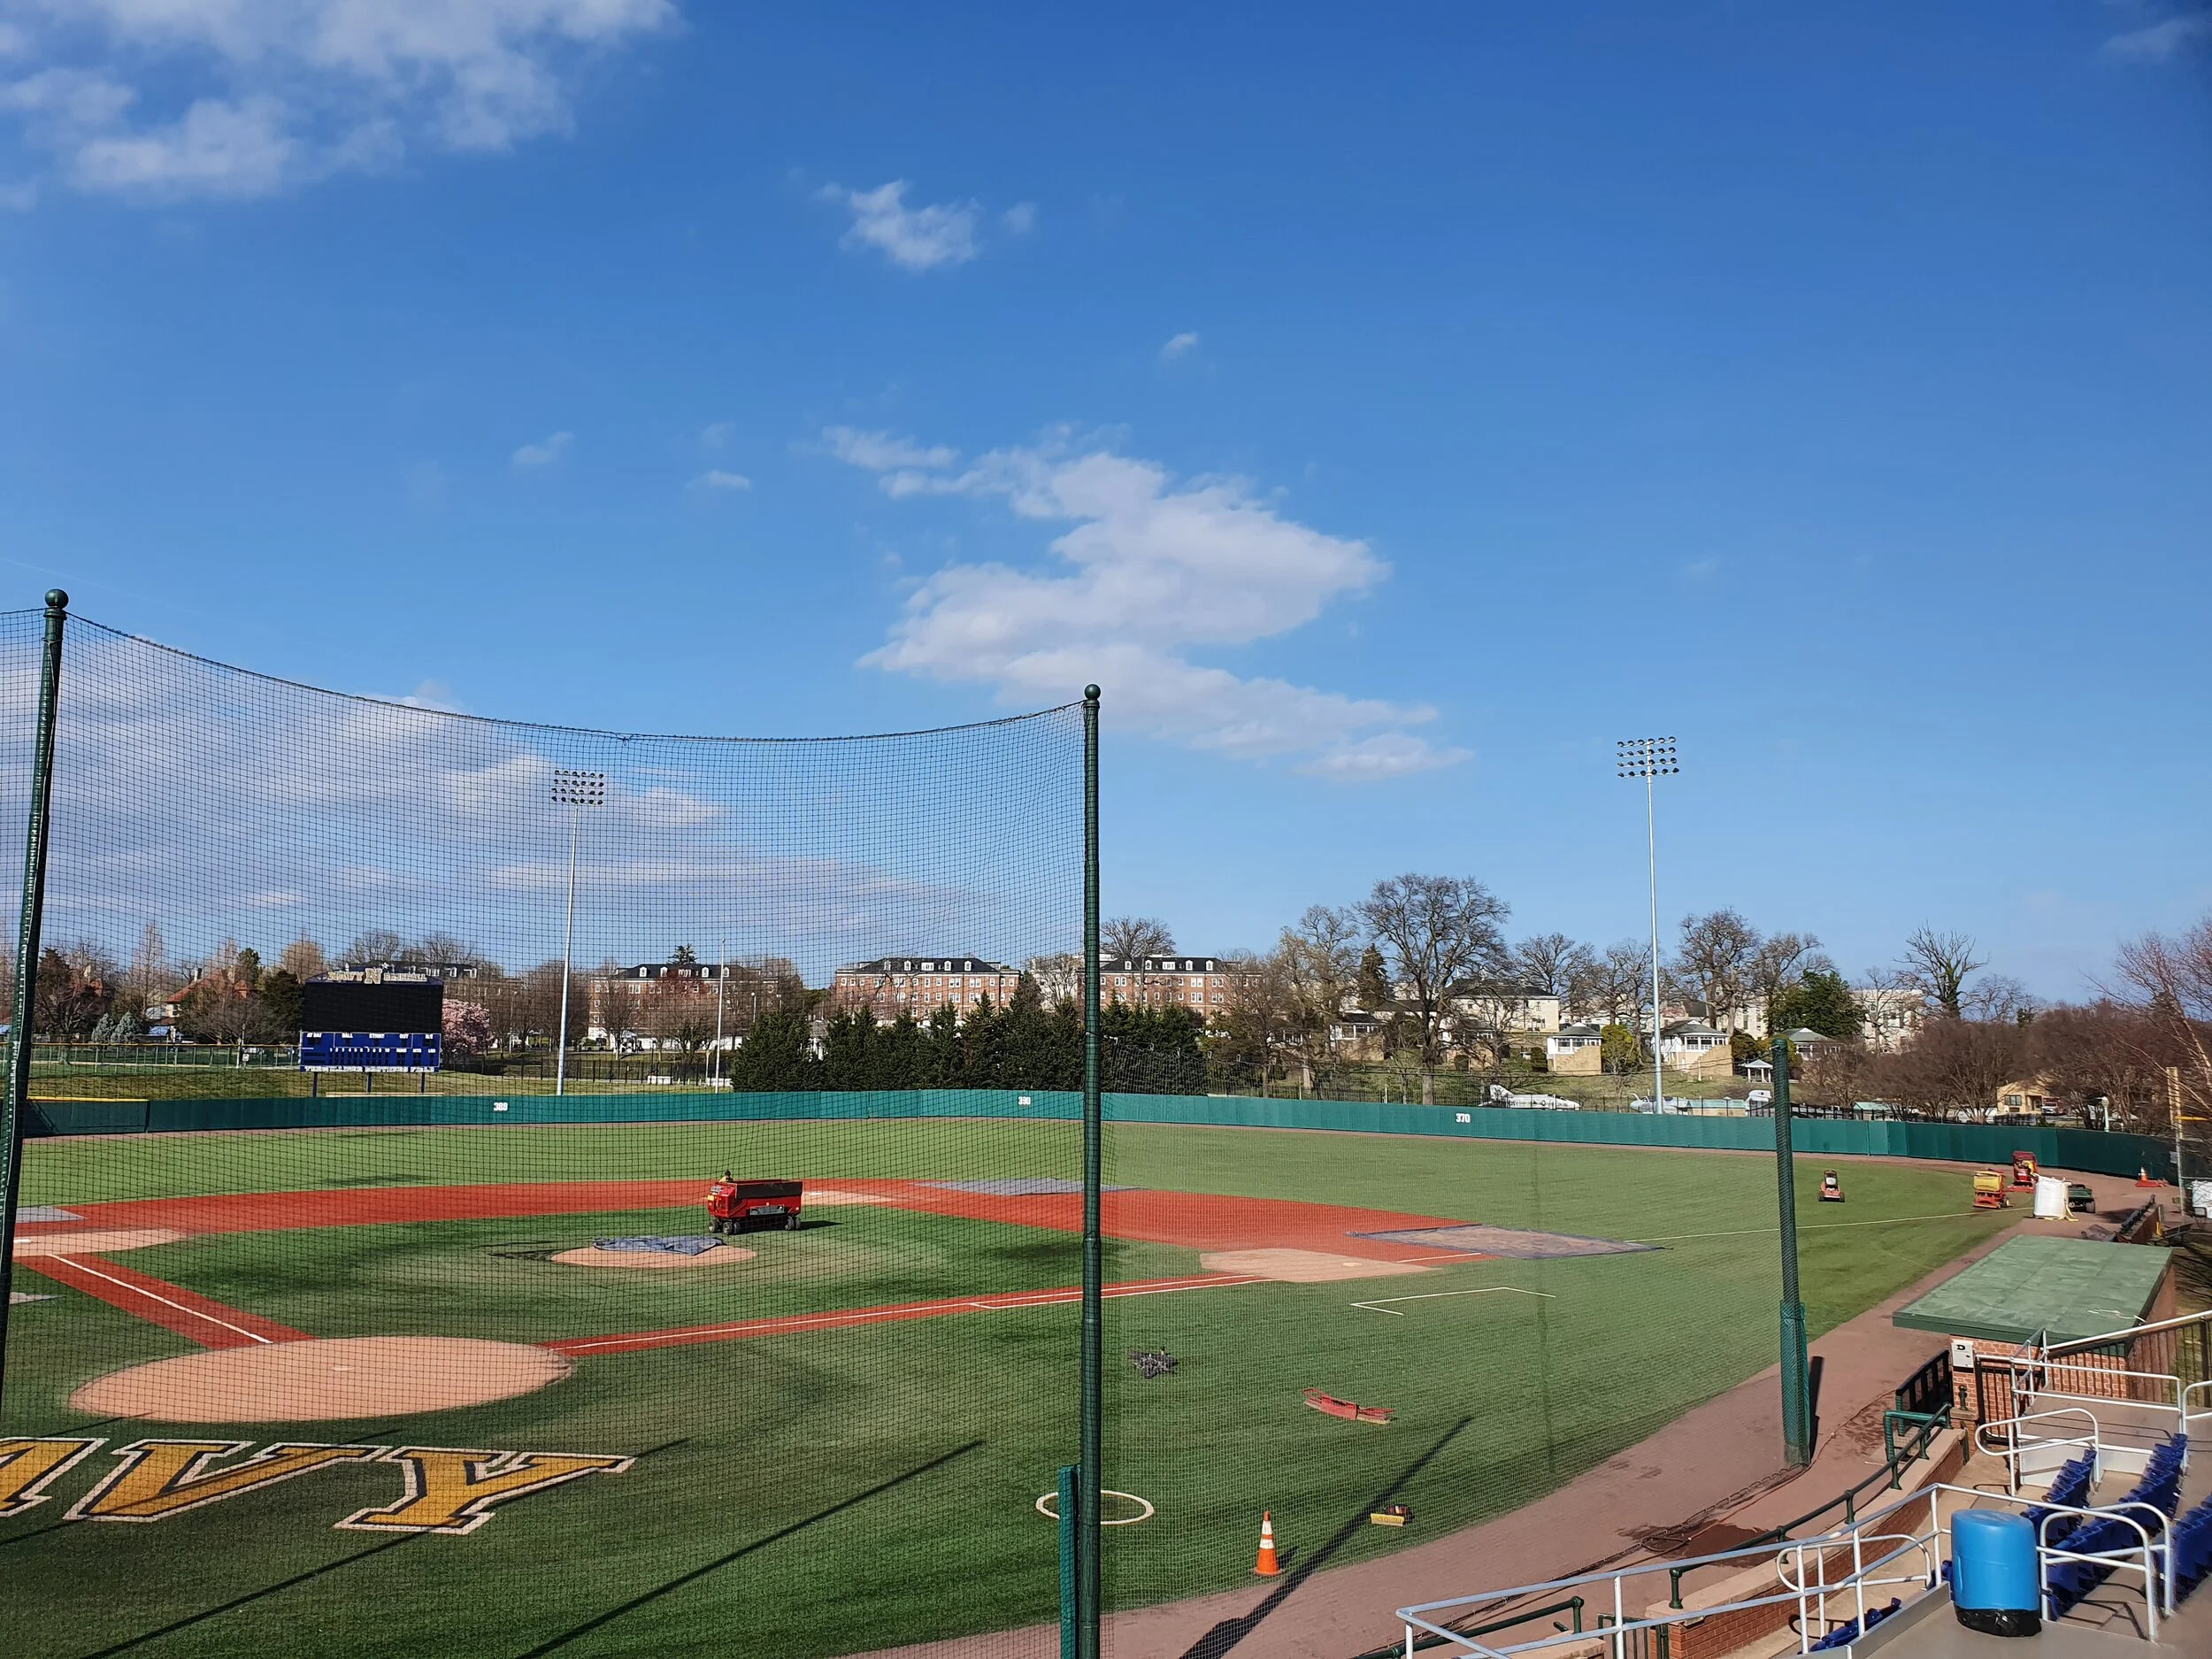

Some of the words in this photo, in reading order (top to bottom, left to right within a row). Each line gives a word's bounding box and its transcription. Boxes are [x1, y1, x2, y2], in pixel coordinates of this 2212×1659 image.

[327, 972, 365, 981] NAVY
[365, 968, 383, 984] N
[1455, 1112, 1471, 1123] 370
